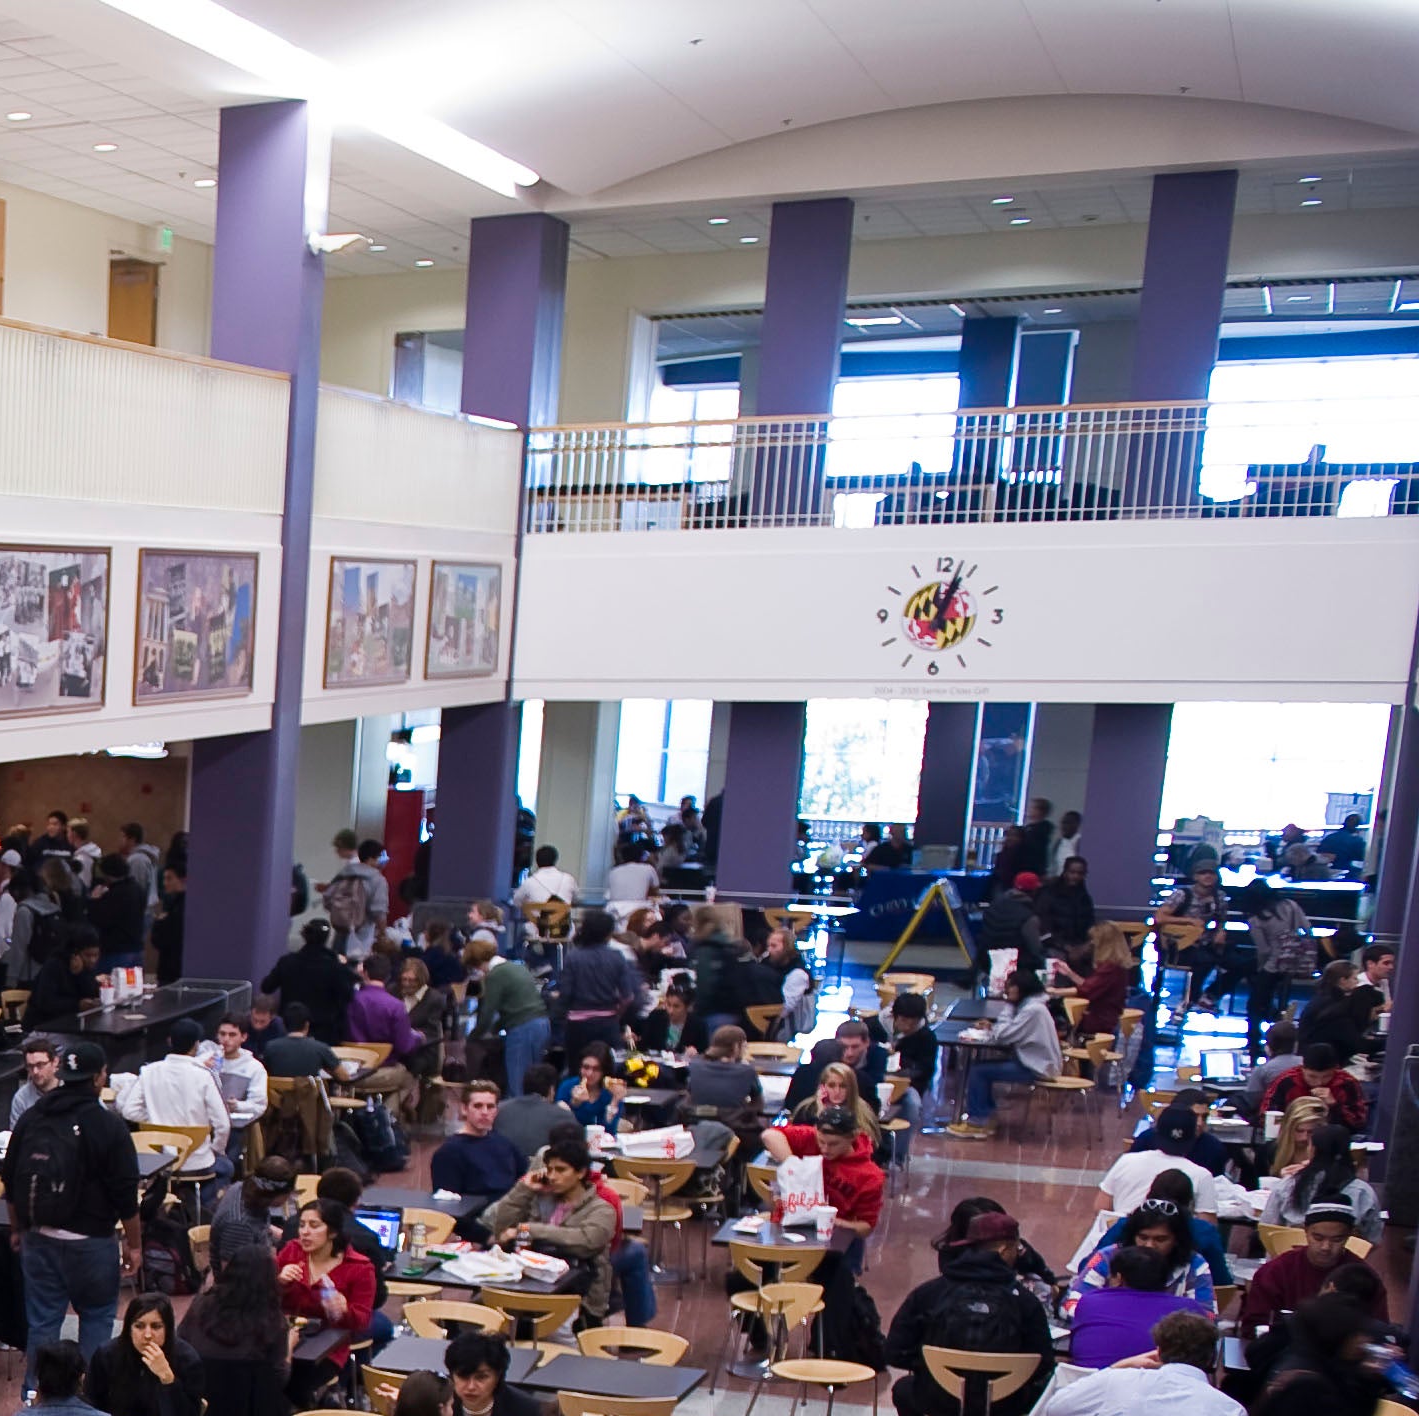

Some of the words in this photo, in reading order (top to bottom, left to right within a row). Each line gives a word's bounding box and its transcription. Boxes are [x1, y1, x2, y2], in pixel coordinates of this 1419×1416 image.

[937, 557, 954, 572] 12
[877, 608, 889, 624] 9
[991, 608, 1004, 624] 3
[927, 660, 940, 676] 6
